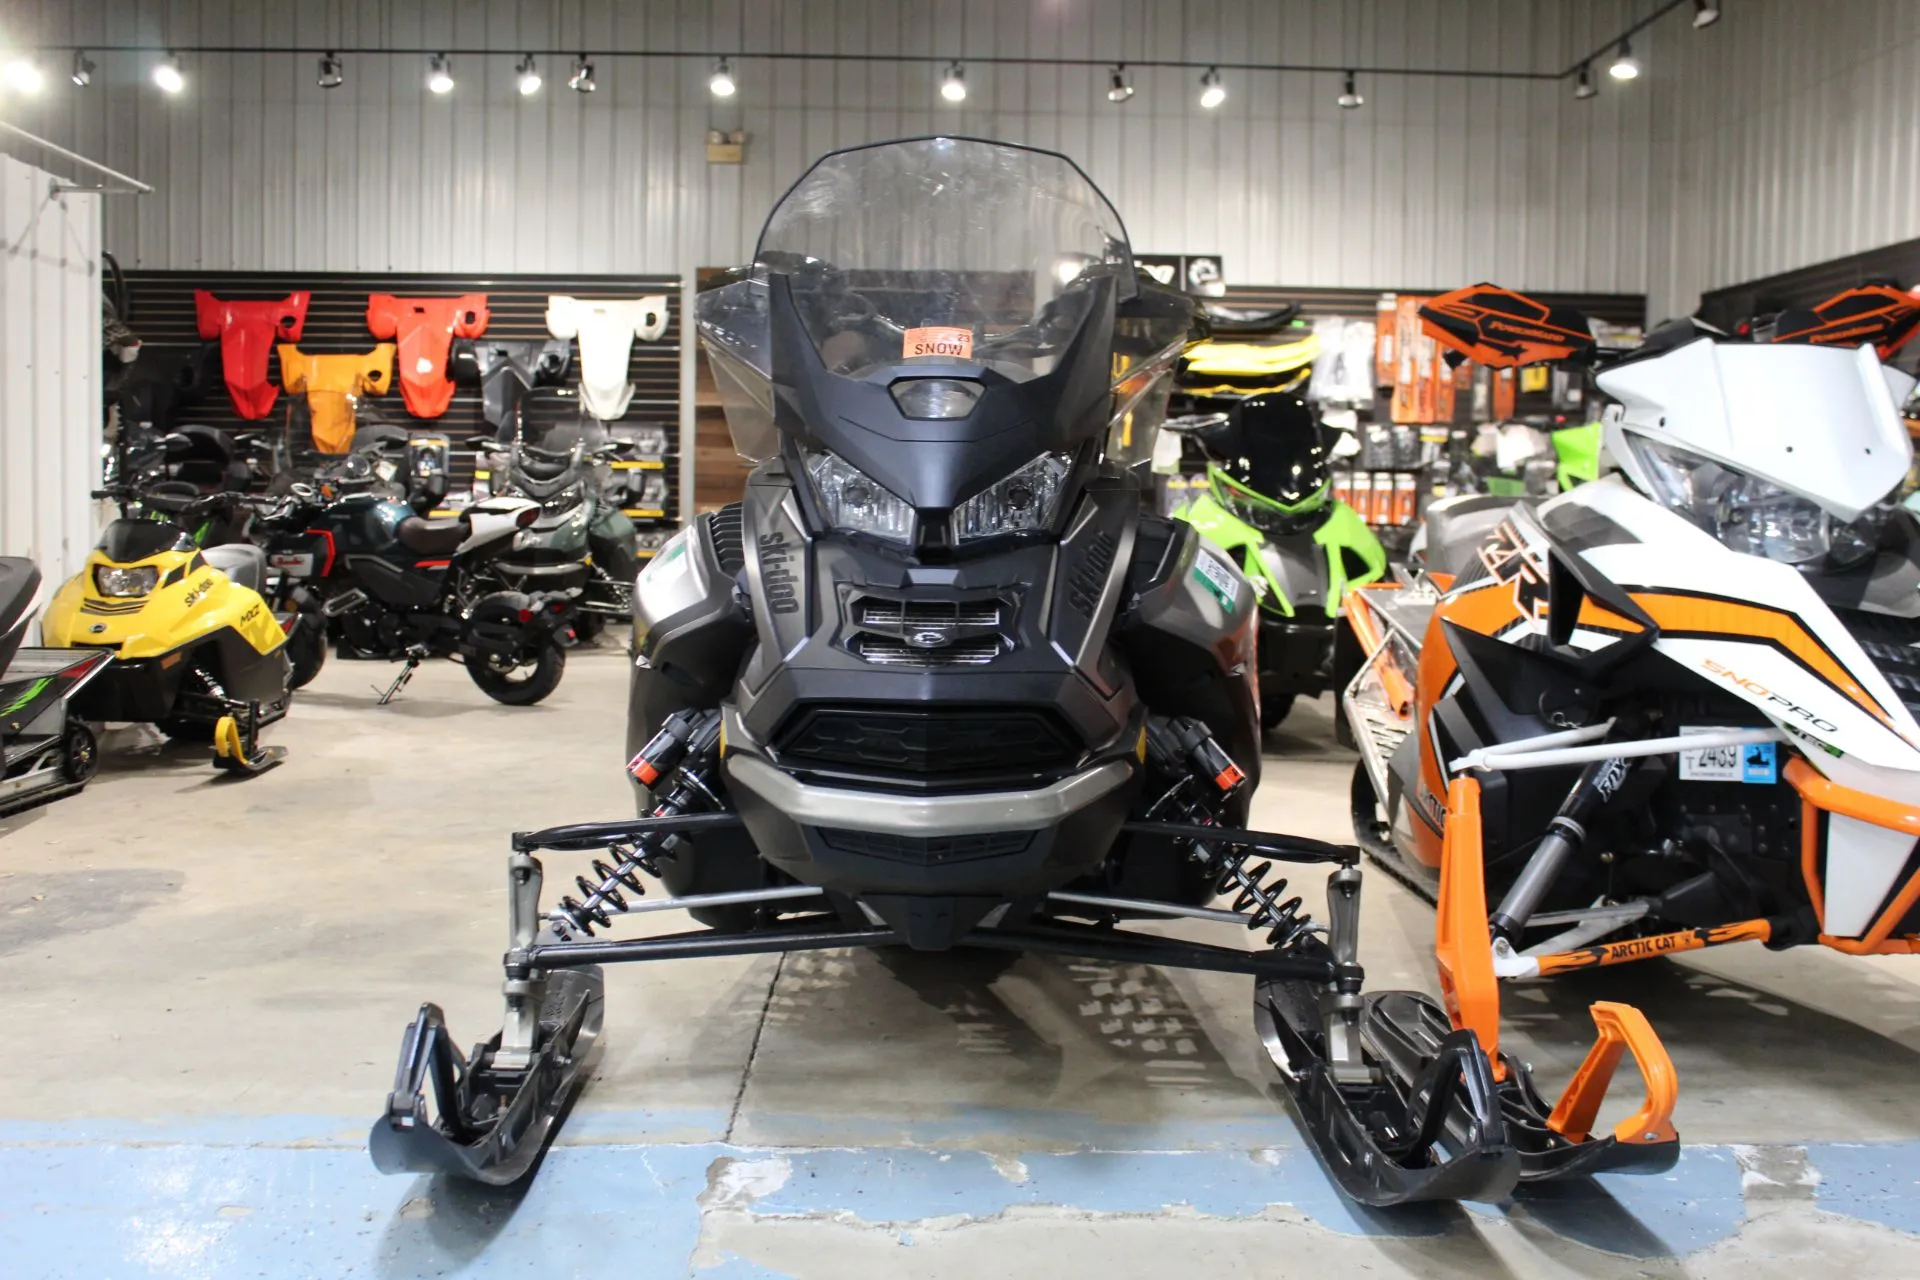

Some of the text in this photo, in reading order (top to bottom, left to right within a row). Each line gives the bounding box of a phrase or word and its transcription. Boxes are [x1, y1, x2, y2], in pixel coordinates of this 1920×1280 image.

[914, 343, 963, 355] SNOW
[1611, 935, 1676, 959] ARCTIC CAT
